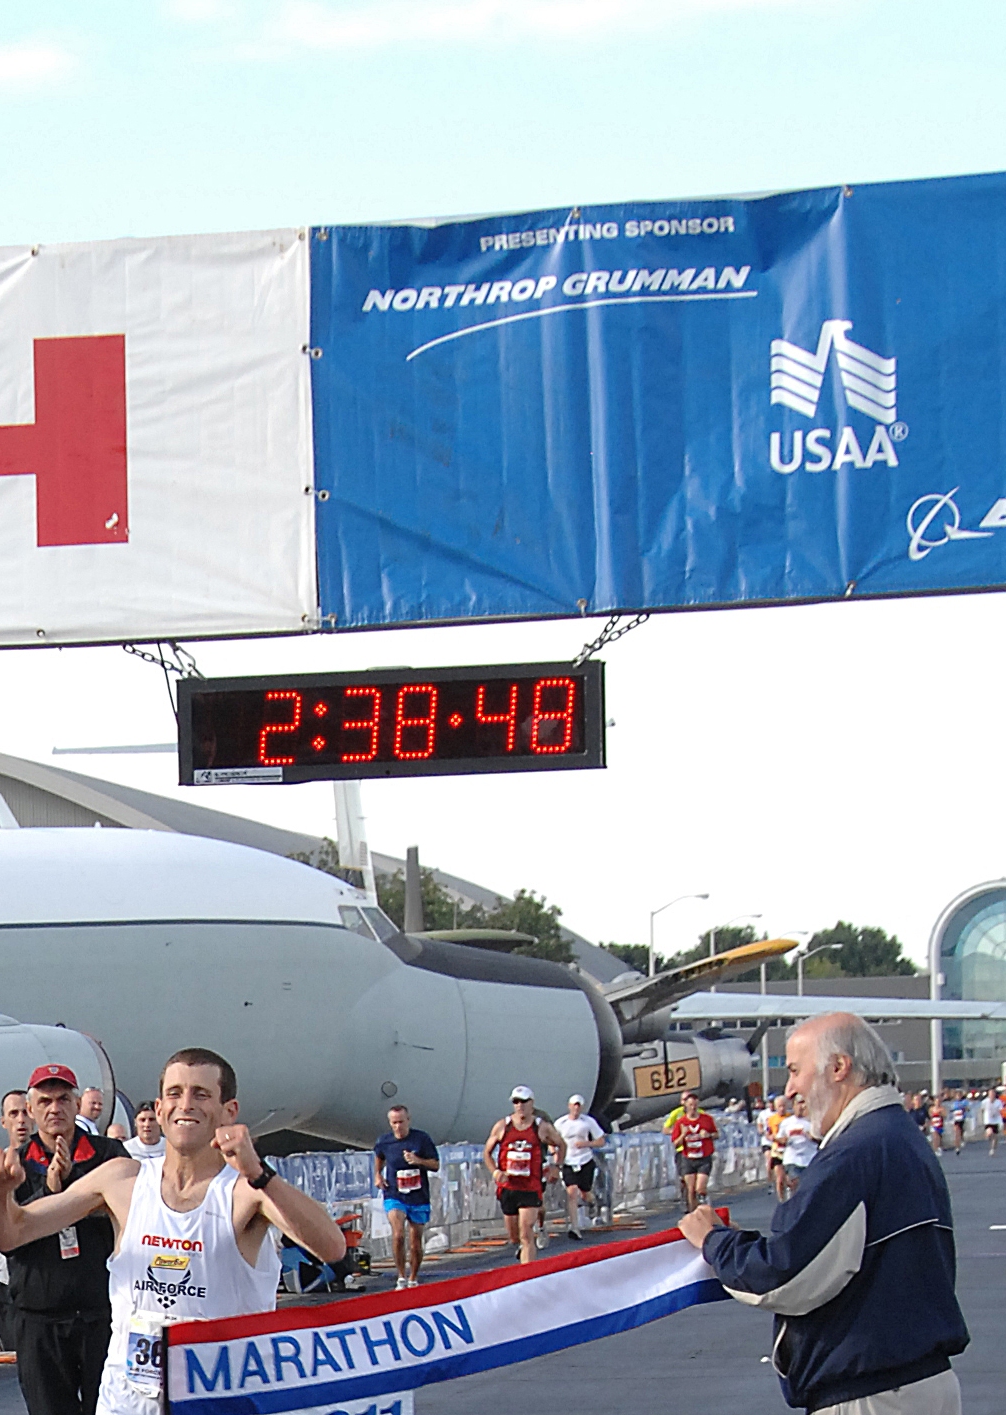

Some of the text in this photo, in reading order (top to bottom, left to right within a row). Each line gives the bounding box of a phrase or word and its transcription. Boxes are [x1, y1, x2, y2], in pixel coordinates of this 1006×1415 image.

[479, 216, 736, 252] PRESENTING SPONSOR
[362, 266, 752, 313] NORTHROP GRUMMAN
[134, 1280, 207, 1298] AIR FORCE
[184, 1304, 475, 1394] MARATHON
